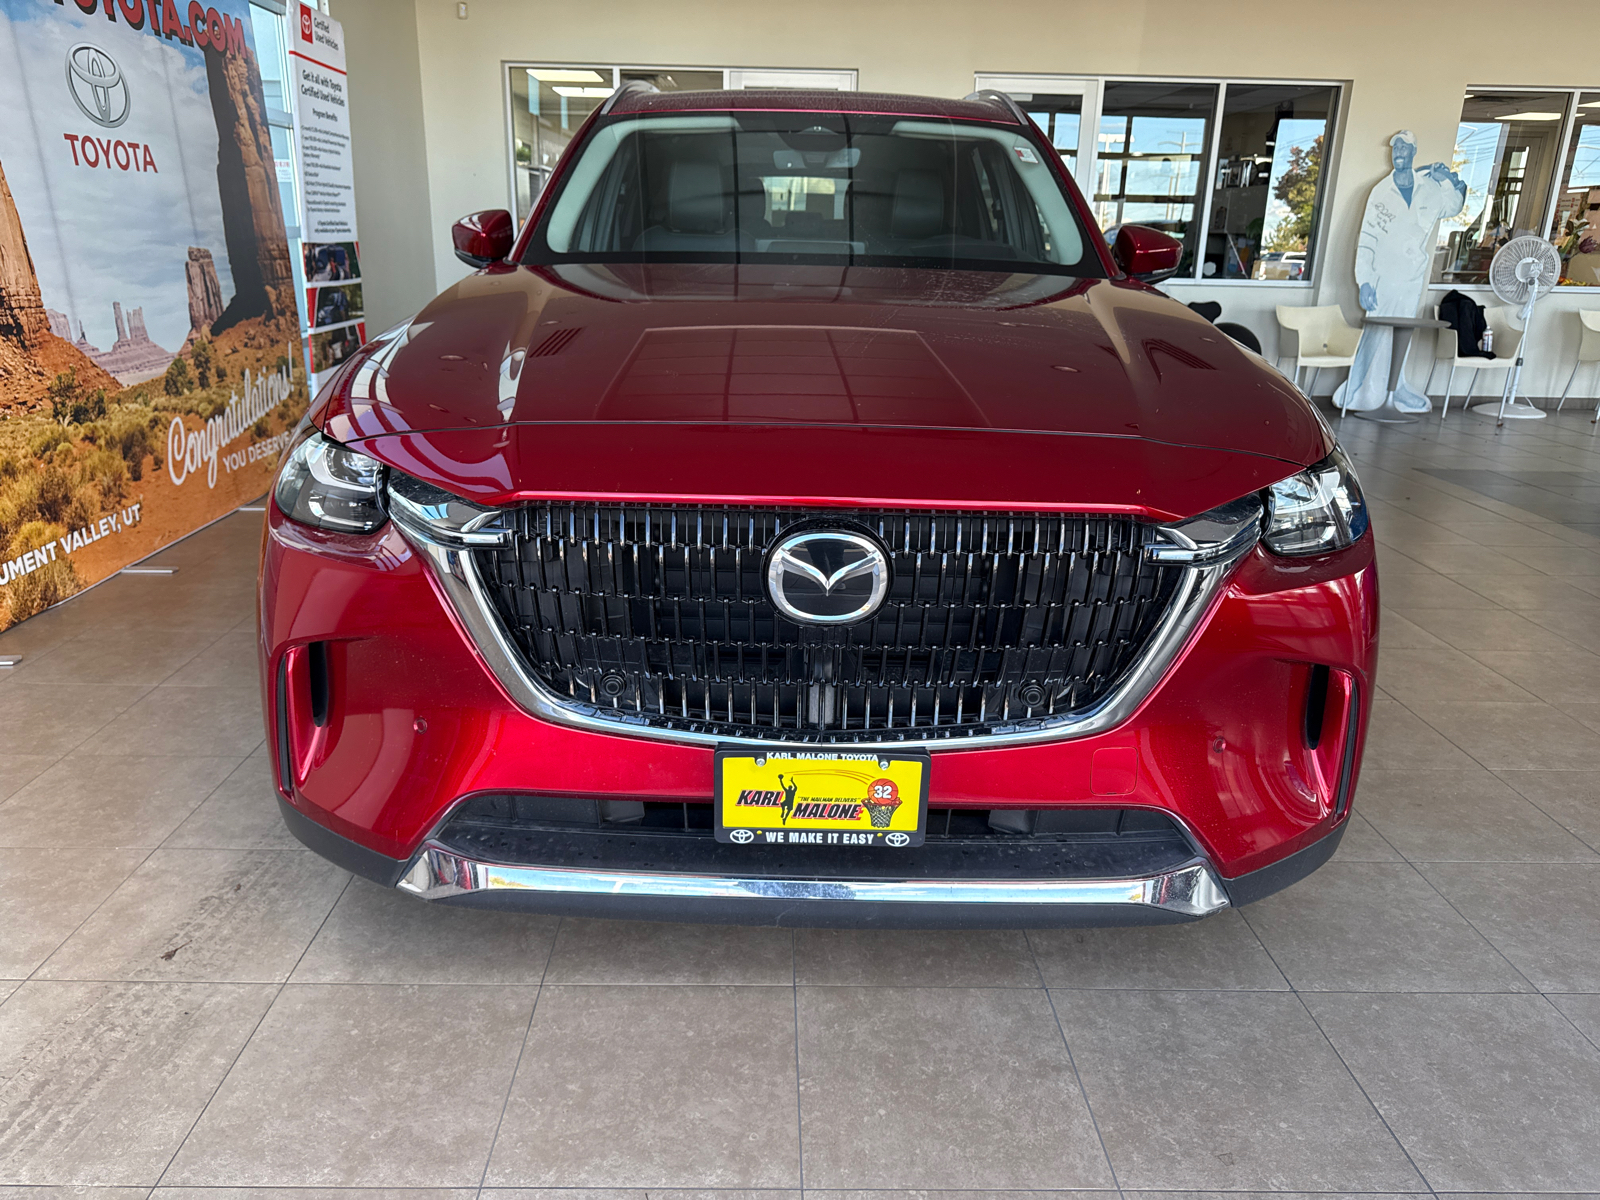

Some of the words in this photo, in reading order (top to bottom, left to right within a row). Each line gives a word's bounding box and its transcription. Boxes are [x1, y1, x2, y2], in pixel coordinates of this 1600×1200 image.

[313, 17, 330, 34] Certified
[301, 84, 320, 99] Certified
[64, 133, 158, 173] TOYOTA
[168, 341, 294, 489] Congratulations!
[223, 449, 246, 473] YOU
[60, 513, 121, 554] VALLEY,
[122, 504, 141, 526] UT
[766, 752, 794, 760] KARL
[796, 752, 838, 761] MALONE
[840, 753, 879, 762] TOYOTA
[736, 789, 785, 808] KARL
[873, 785, 893, 799] 32
[791, 802, 863, 821] MALONE
[765, 831, 785, 843] WE
[788, 832, 824, 844] MAKE
[827, 832, 839, 844] IT
[842, 833, 874, 845] EASY
